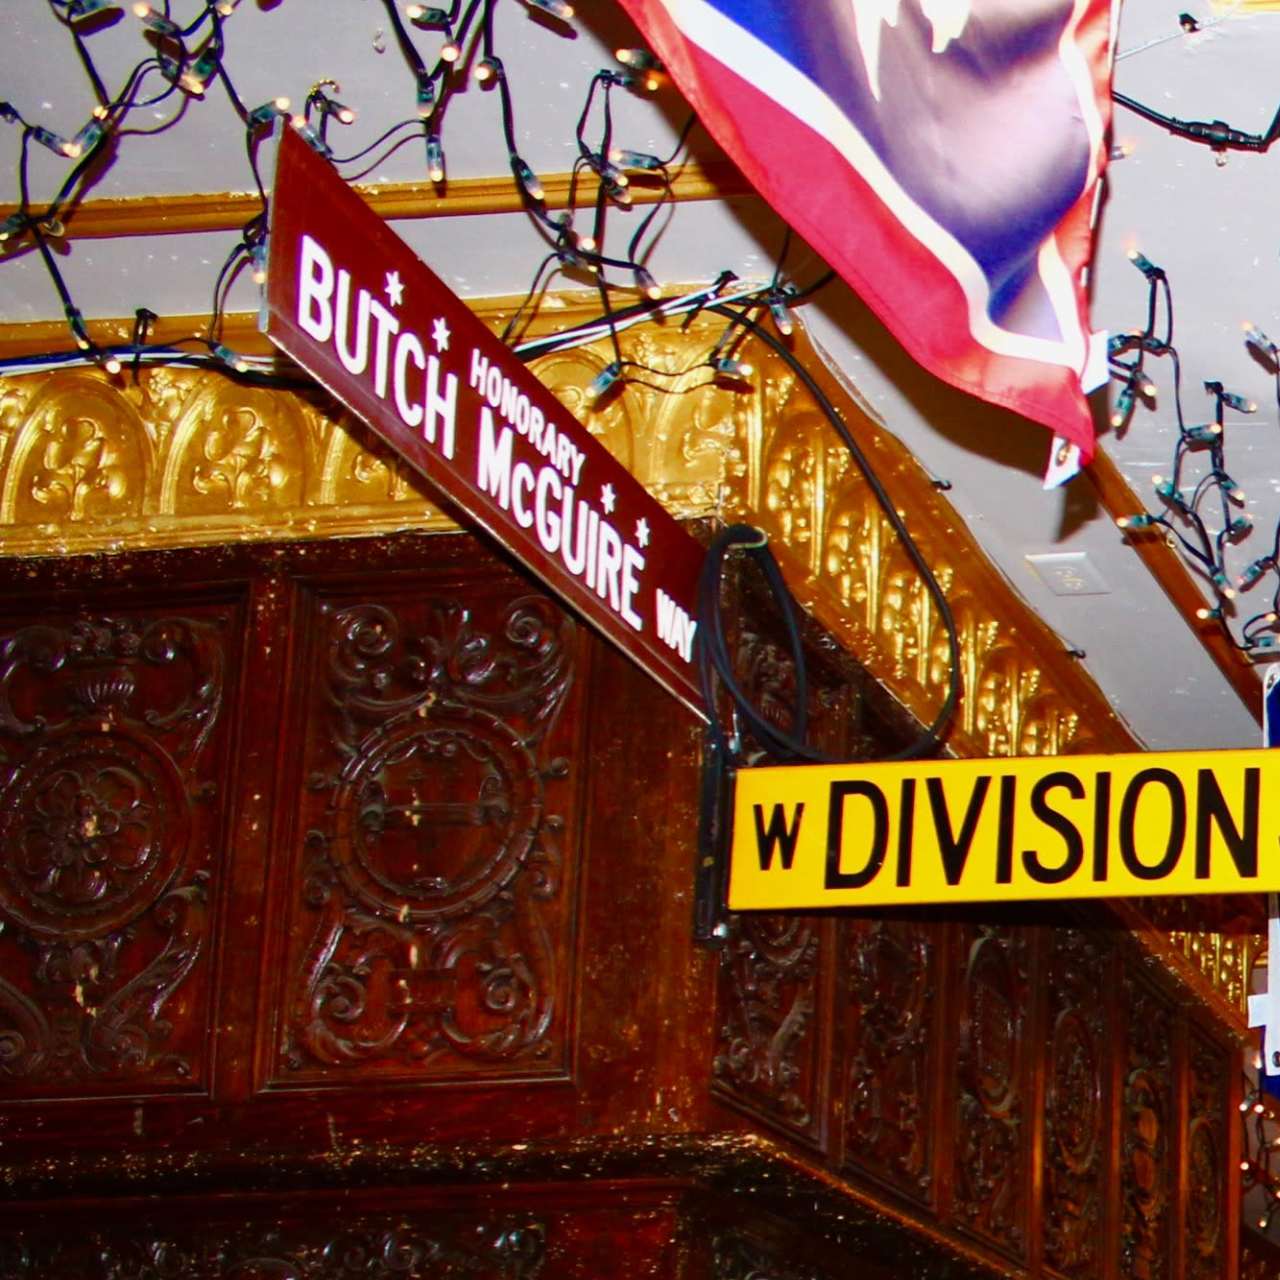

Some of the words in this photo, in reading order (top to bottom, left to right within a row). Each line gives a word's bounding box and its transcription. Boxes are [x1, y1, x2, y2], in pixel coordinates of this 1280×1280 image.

[296, 233, 459, 461] BUTCH
[476, 404, 646, 632] McGUIRE
[655, 587, 698, 664] WAY
[470, 346, 587, 487] HONORARY
[752, 802, 805, 872] W
[824, 766, 1261, 891] DIVISION
